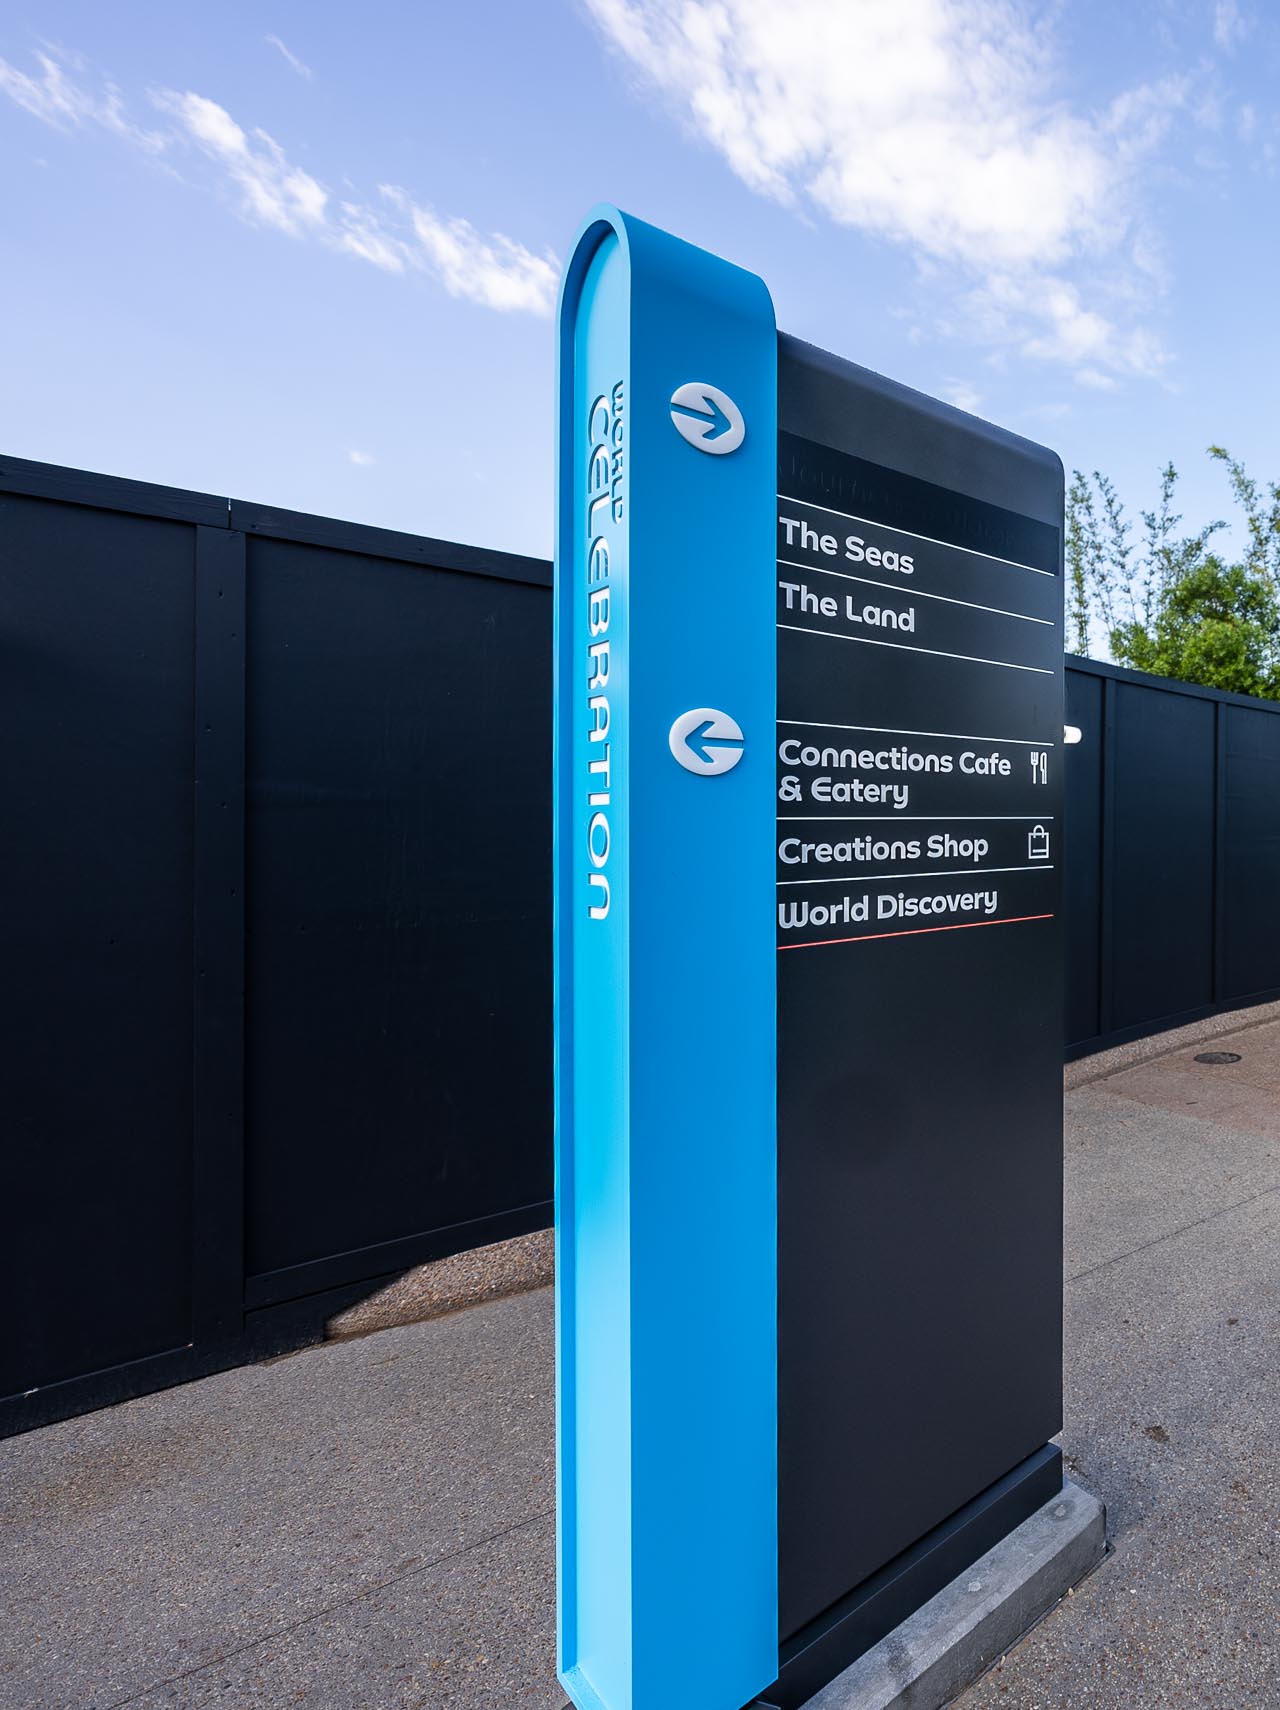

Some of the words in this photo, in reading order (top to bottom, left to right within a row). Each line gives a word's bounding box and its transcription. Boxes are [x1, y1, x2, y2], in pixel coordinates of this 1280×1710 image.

[612, 380, 624, 525] WORLD
[778, 516, 838, 556] The
[844, 535, 915, 575] Seas
[778, 581, 838, 617] The
[845, 595, 915, 633] Land
[588, 394, 611, 920] CELEBRATION
[778, 739, 954, 774] Connections
[958, 751, 1012, 777] Cafe
[778, 775, 803, 802] &
[810, 777, 909, 810] Eatery
[778, 836, 921, 865] Creations
[926, 832, 989, 863] Shop
[778, 894, 870, 930] World
[877, 890, 998, 920] Discovery
